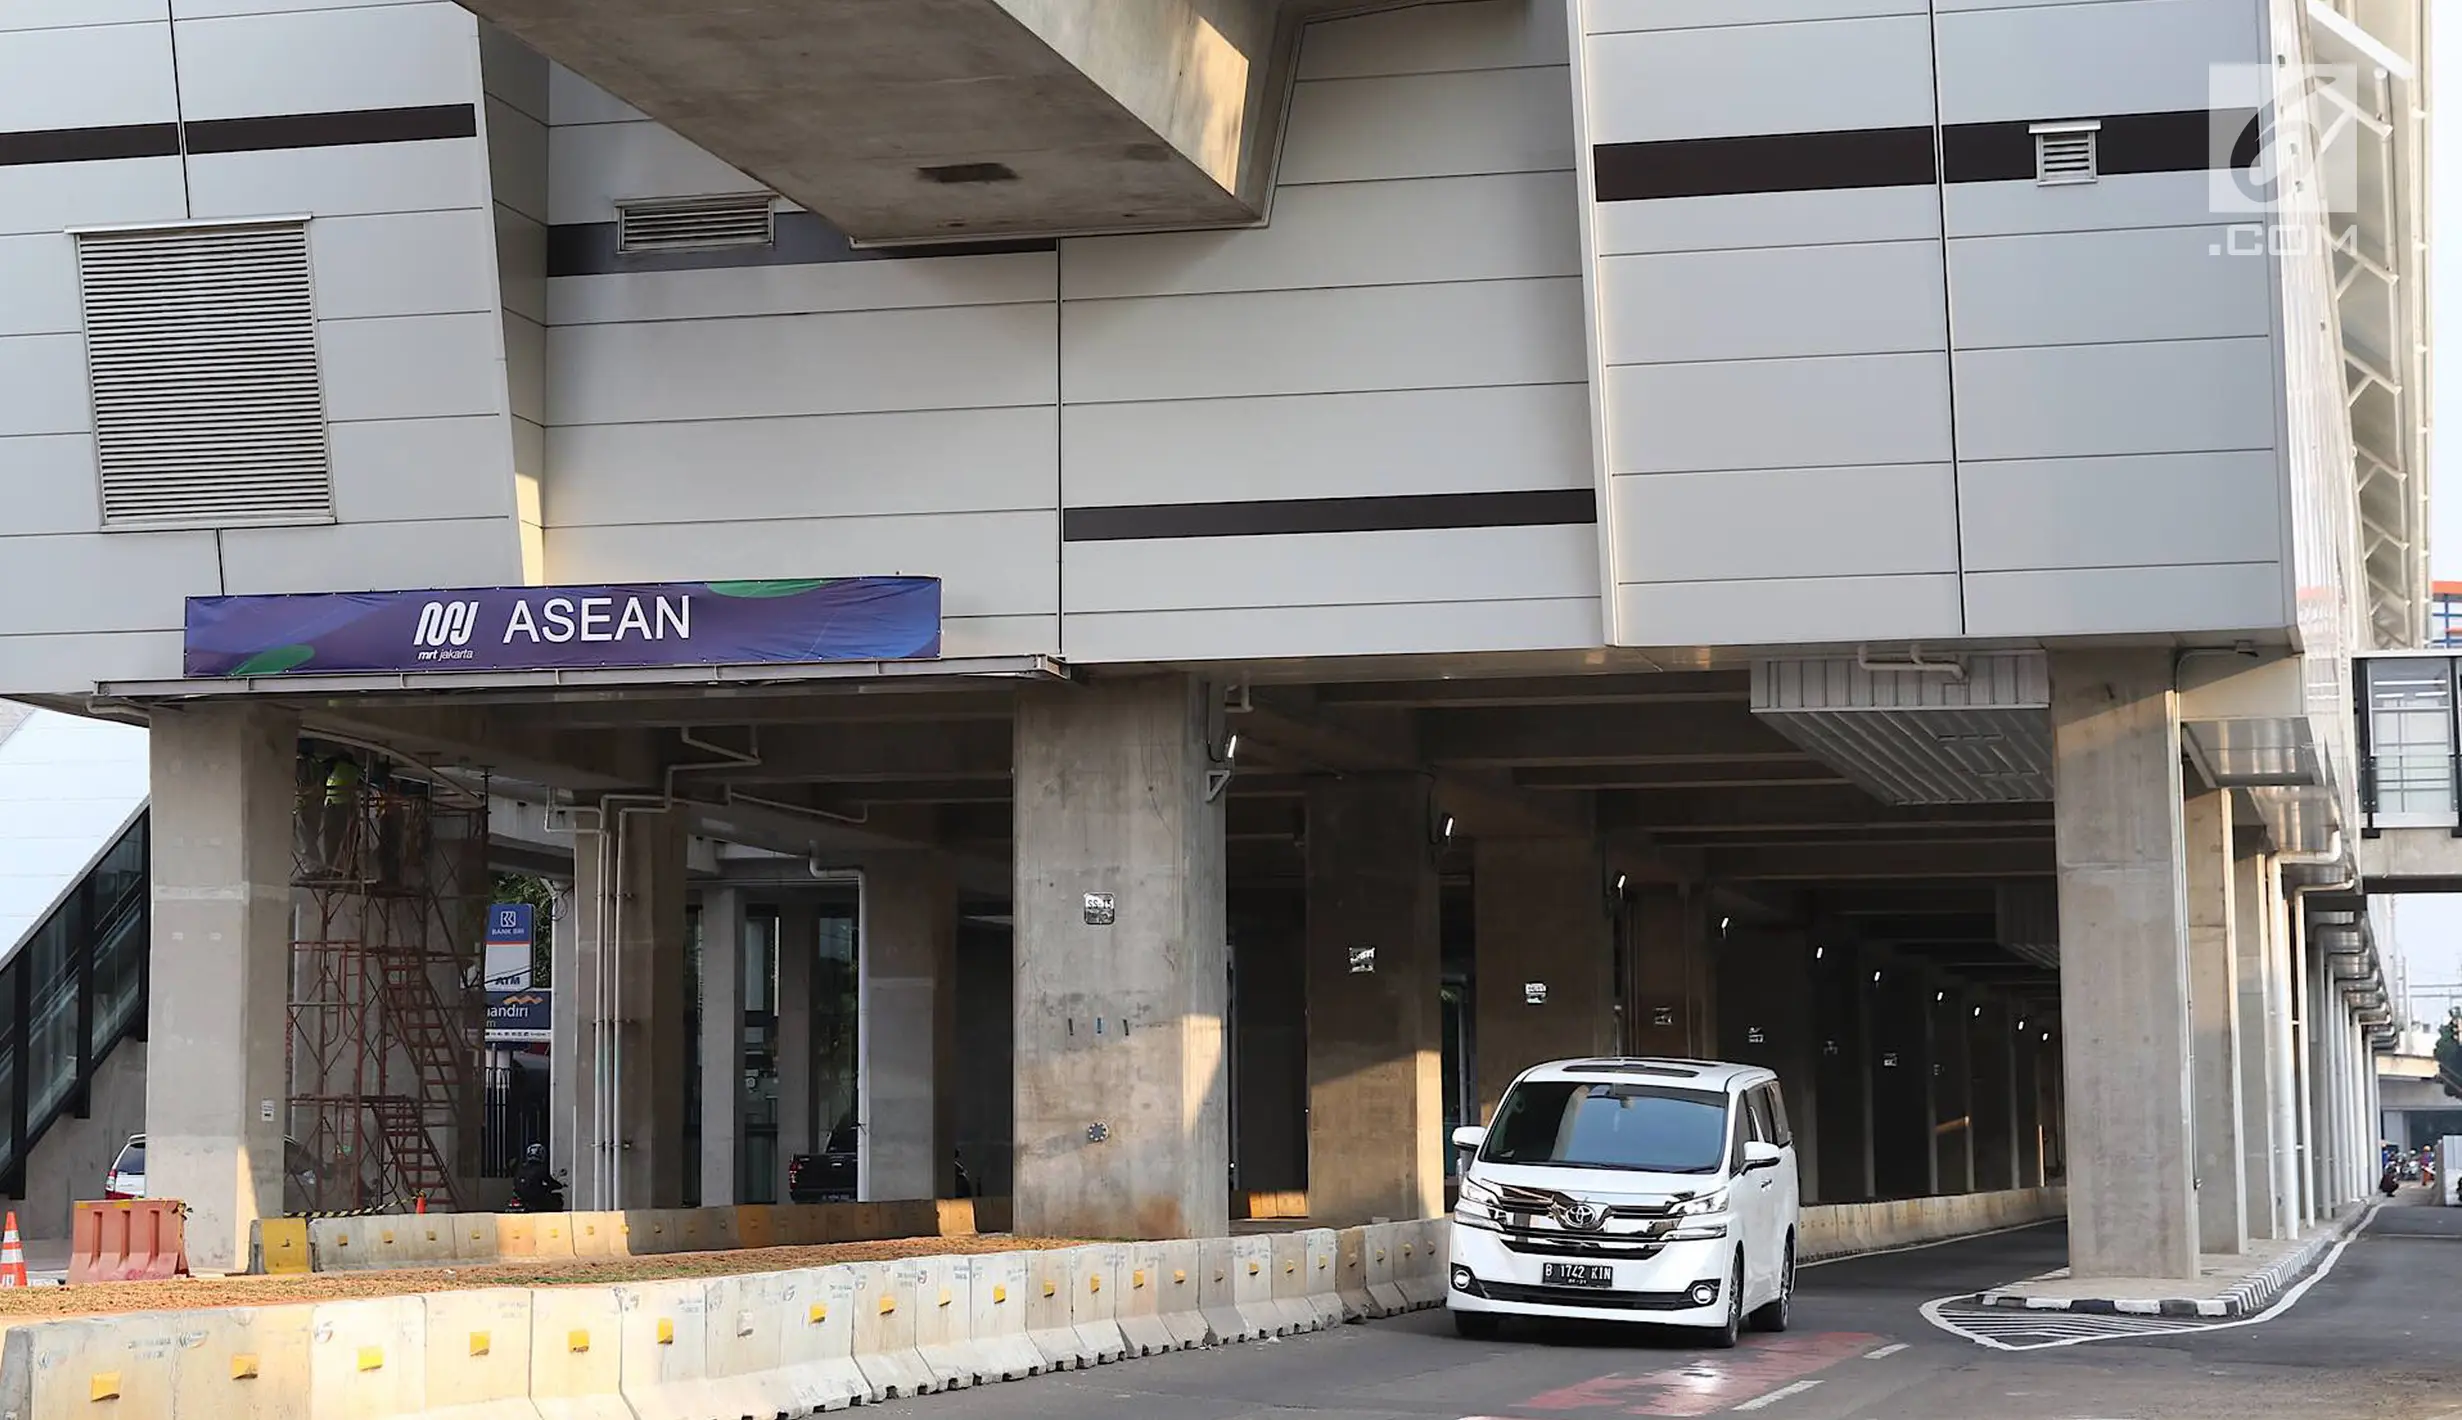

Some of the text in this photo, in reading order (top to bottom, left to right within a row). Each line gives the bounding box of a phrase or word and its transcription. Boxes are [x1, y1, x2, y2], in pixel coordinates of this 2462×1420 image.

[502, 594, 690, 644] ASEAN
[417, 648, 473, 661] mrt jakarta
[491, 928, 511, 936] BANK
[495, 976, 521, 986] ATM
[1545, 1263, 1611, 1280] B 1742 KIN
